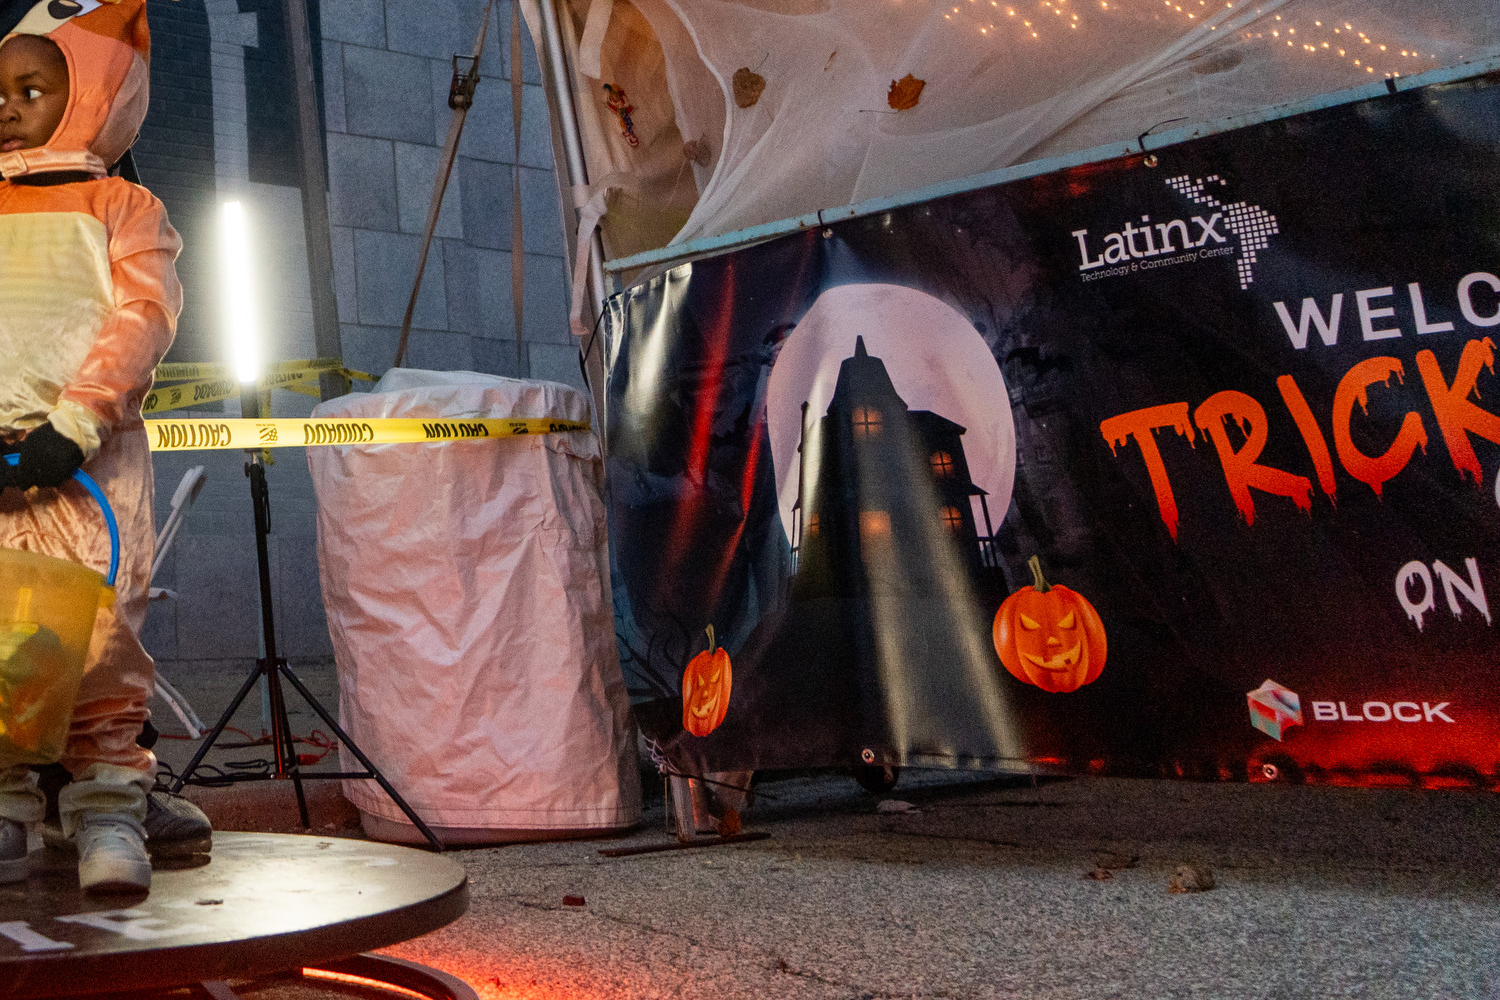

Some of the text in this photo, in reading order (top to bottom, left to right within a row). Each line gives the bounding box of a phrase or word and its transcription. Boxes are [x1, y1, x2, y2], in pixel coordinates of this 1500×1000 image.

[1072, 212, 1227, 271] Latinx
[1080, 245, 1235, 283] Technology & Community Center
[1272, 271, 1500, 350] WELC
[157, 424, 232, 448] CAUTION
[303, 423, 374, 445] CUIDADO
[1100, 336, 1500, 544] TRICK
[1395, 557, 1492, 633] ON
[1311, 701, 1456, 723] BLOCK
